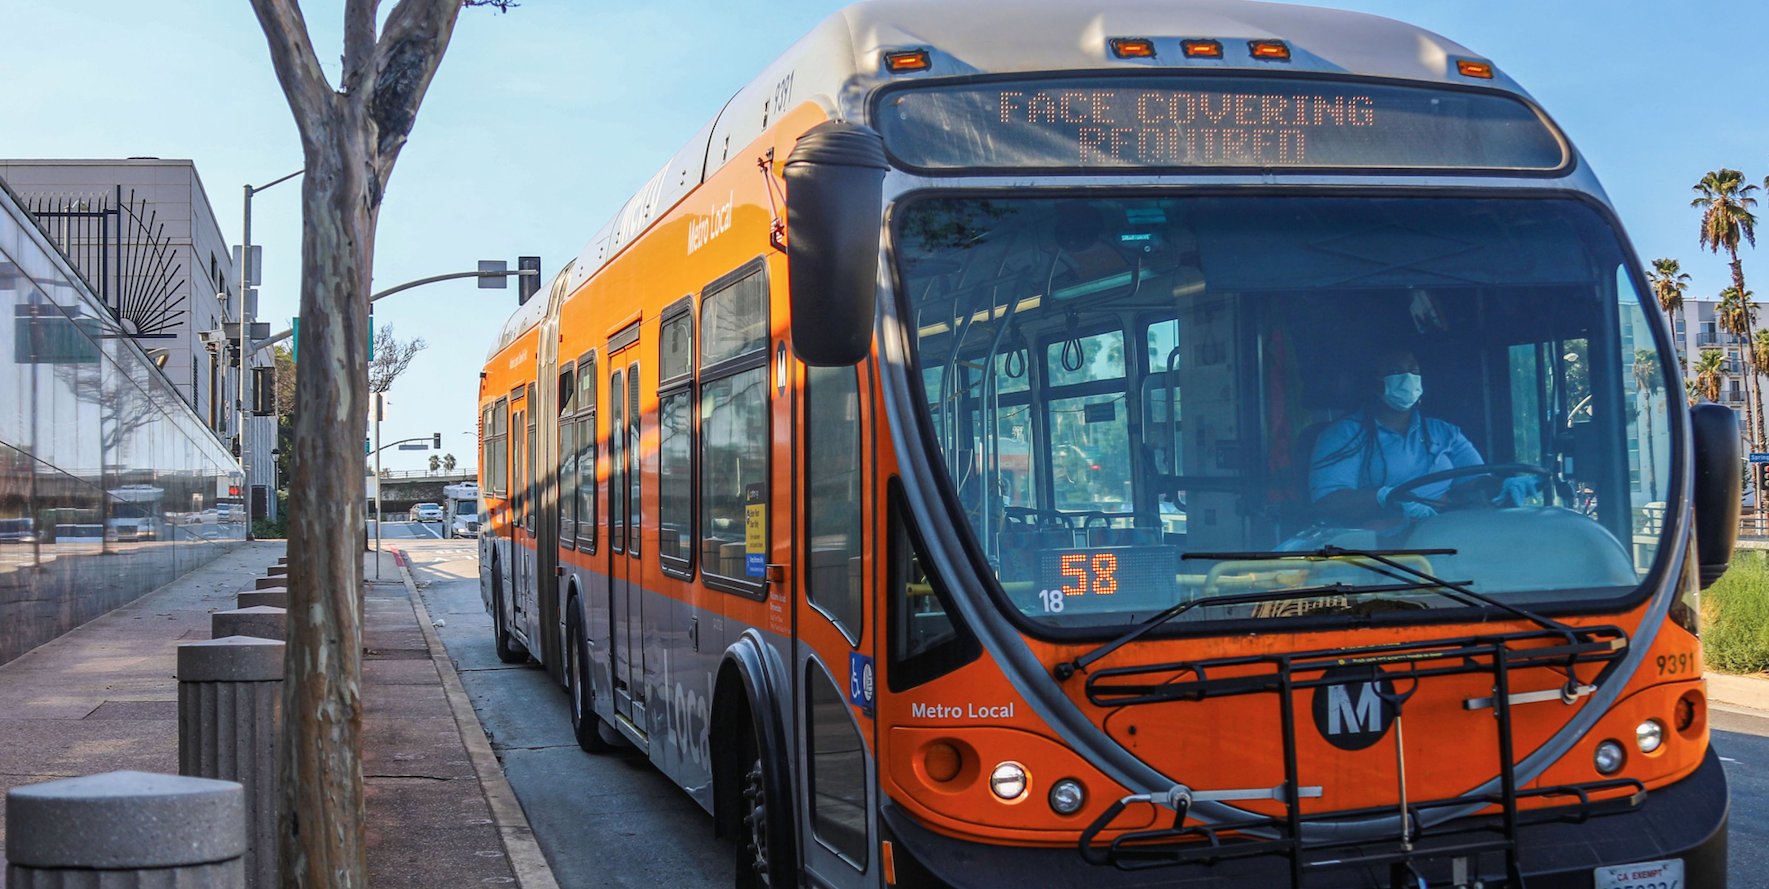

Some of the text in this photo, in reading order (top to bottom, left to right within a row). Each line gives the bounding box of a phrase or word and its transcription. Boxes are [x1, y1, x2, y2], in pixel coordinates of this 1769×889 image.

[773, 69, 795, 115] 9391
[1000, 92, 1374, 126] FACE COVERING
[1079, 128, 1305, 165] REQUIRED
[687, 215, 709, 256] Metro
[710, 189, 734, 240] Local
[1061, 553, 1117, 596] 58
[1039, 589, 1064, 613] 18
[1656, 652, 1694, 676] 9391
[911, 701, 1014, 719] Metro Local
[1327, 681, 1382, 735] M
[1616, 868, 1664, 882] CA EXEMPT
